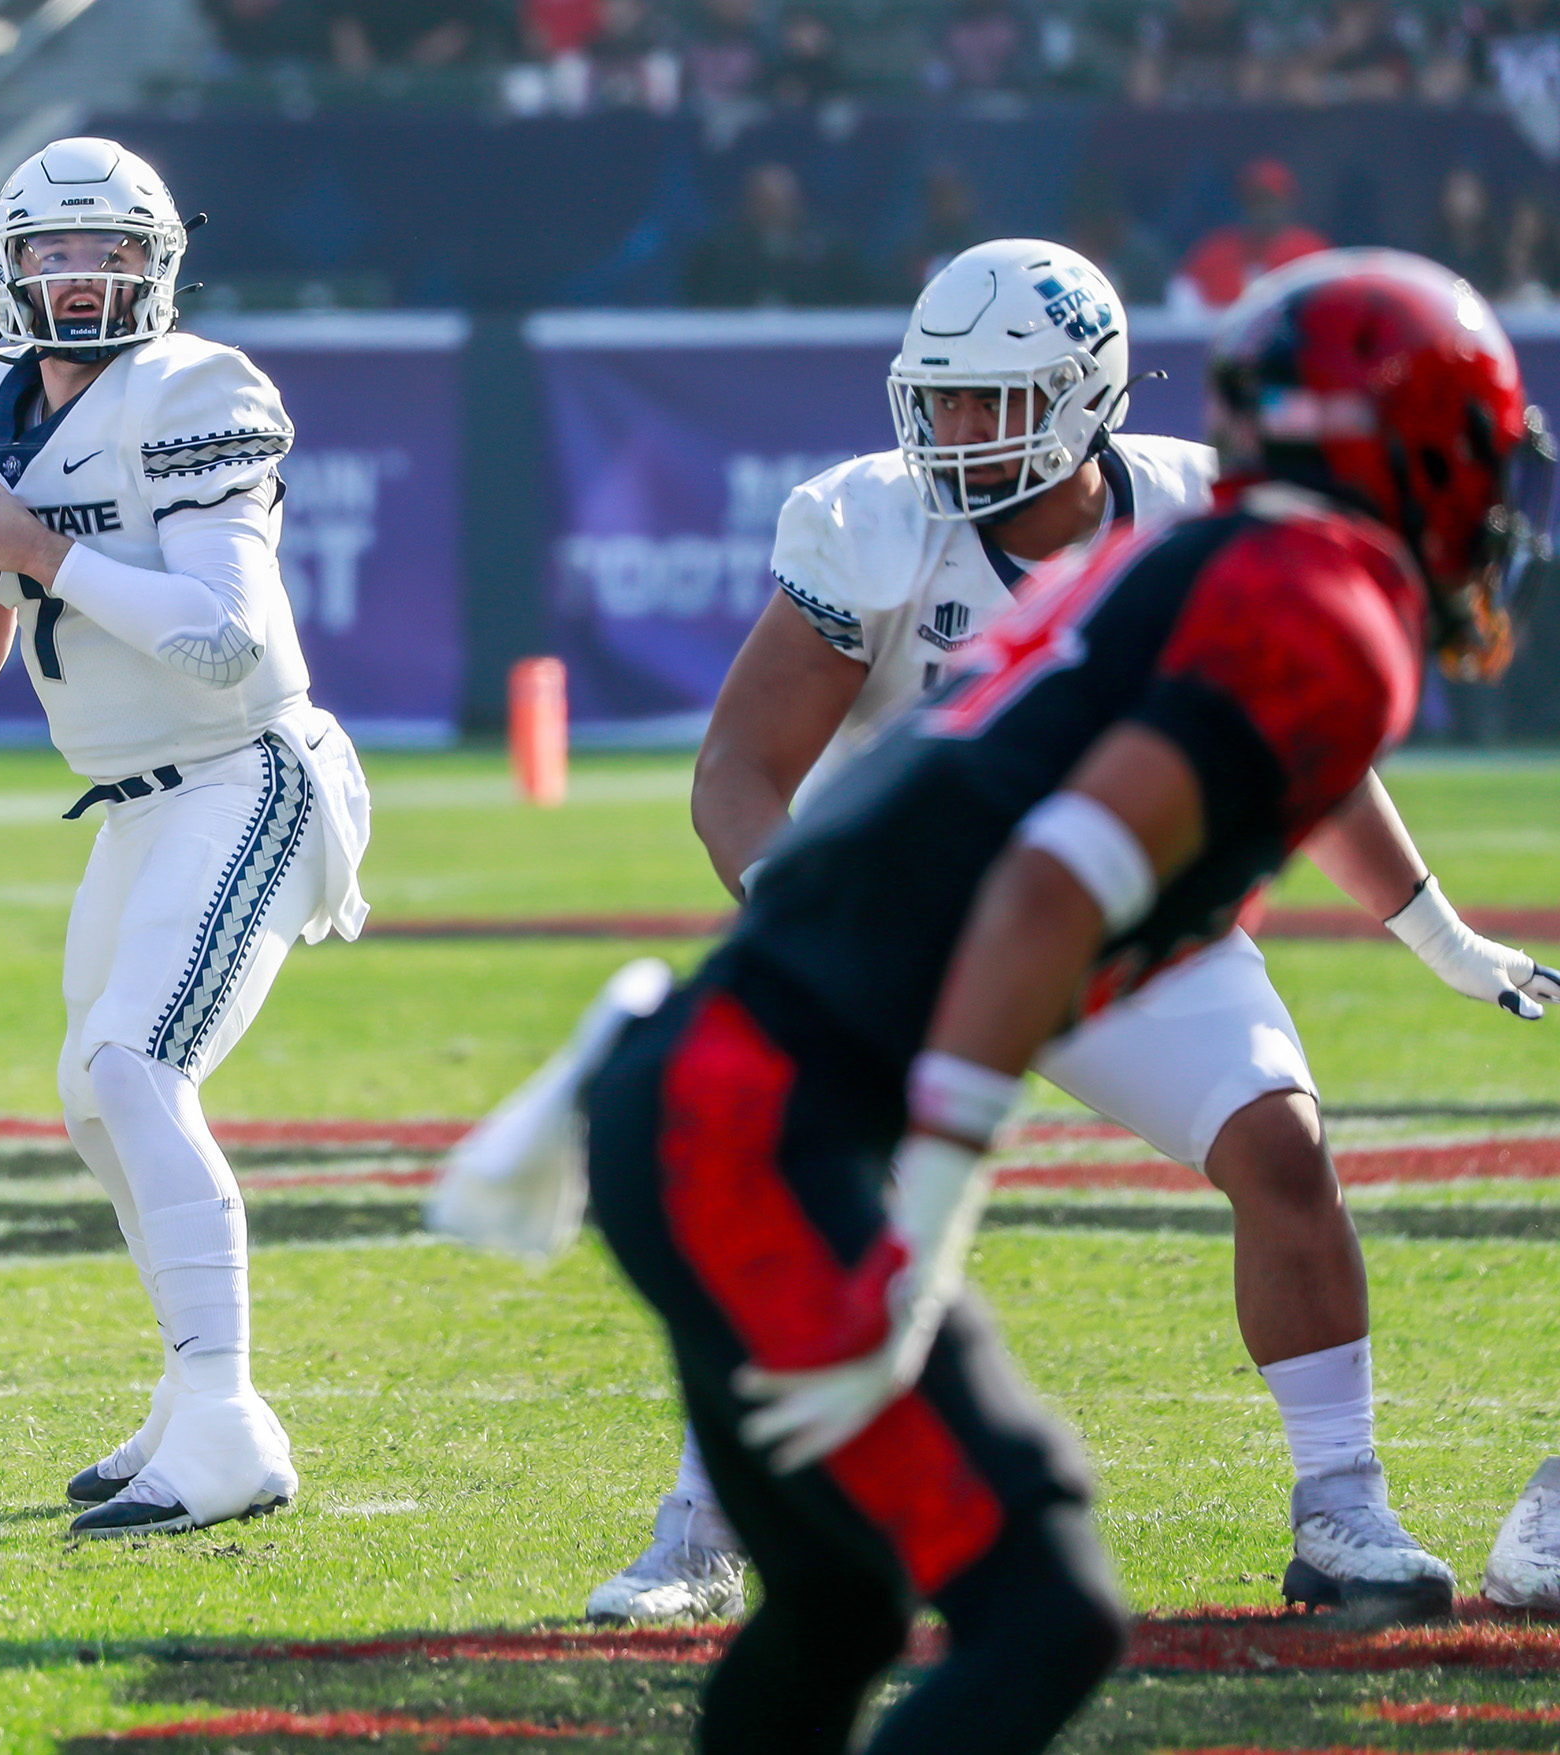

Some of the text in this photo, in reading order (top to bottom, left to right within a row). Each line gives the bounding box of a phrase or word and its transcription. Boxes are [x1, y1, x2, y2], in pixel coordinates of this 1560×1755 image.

[60, 197, 95, 207] AGGIES
[70, 327, 97, 336] Riddell
[23, 499, 124, 536] TATE
